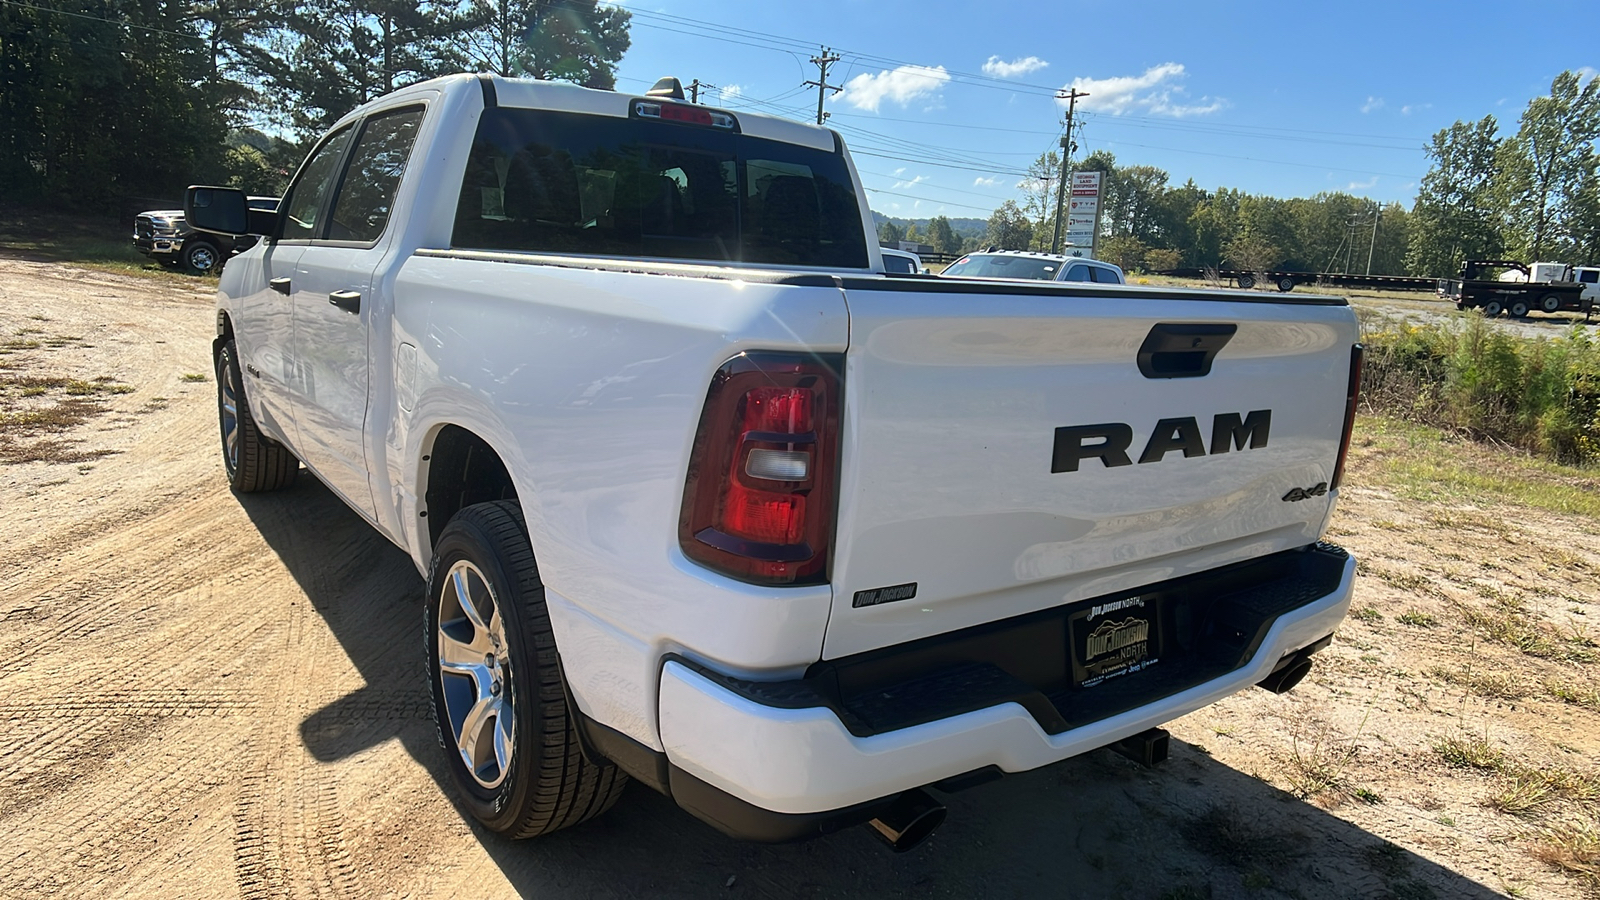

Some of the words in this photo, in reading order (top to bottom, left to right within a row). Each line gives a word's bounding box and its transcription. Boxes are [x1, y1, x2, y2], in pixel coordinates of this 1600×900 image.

[1051, 409, 1272, 474] RAM
[875, 585, 915, 603] JACKSON
[1121, 596, 1141, 608] NORTH
[1086, 636, 1108, 660] DON
[1108, 621, 1148, 651] JACKSON
[1120, 641, 1148, 660] NORTH
